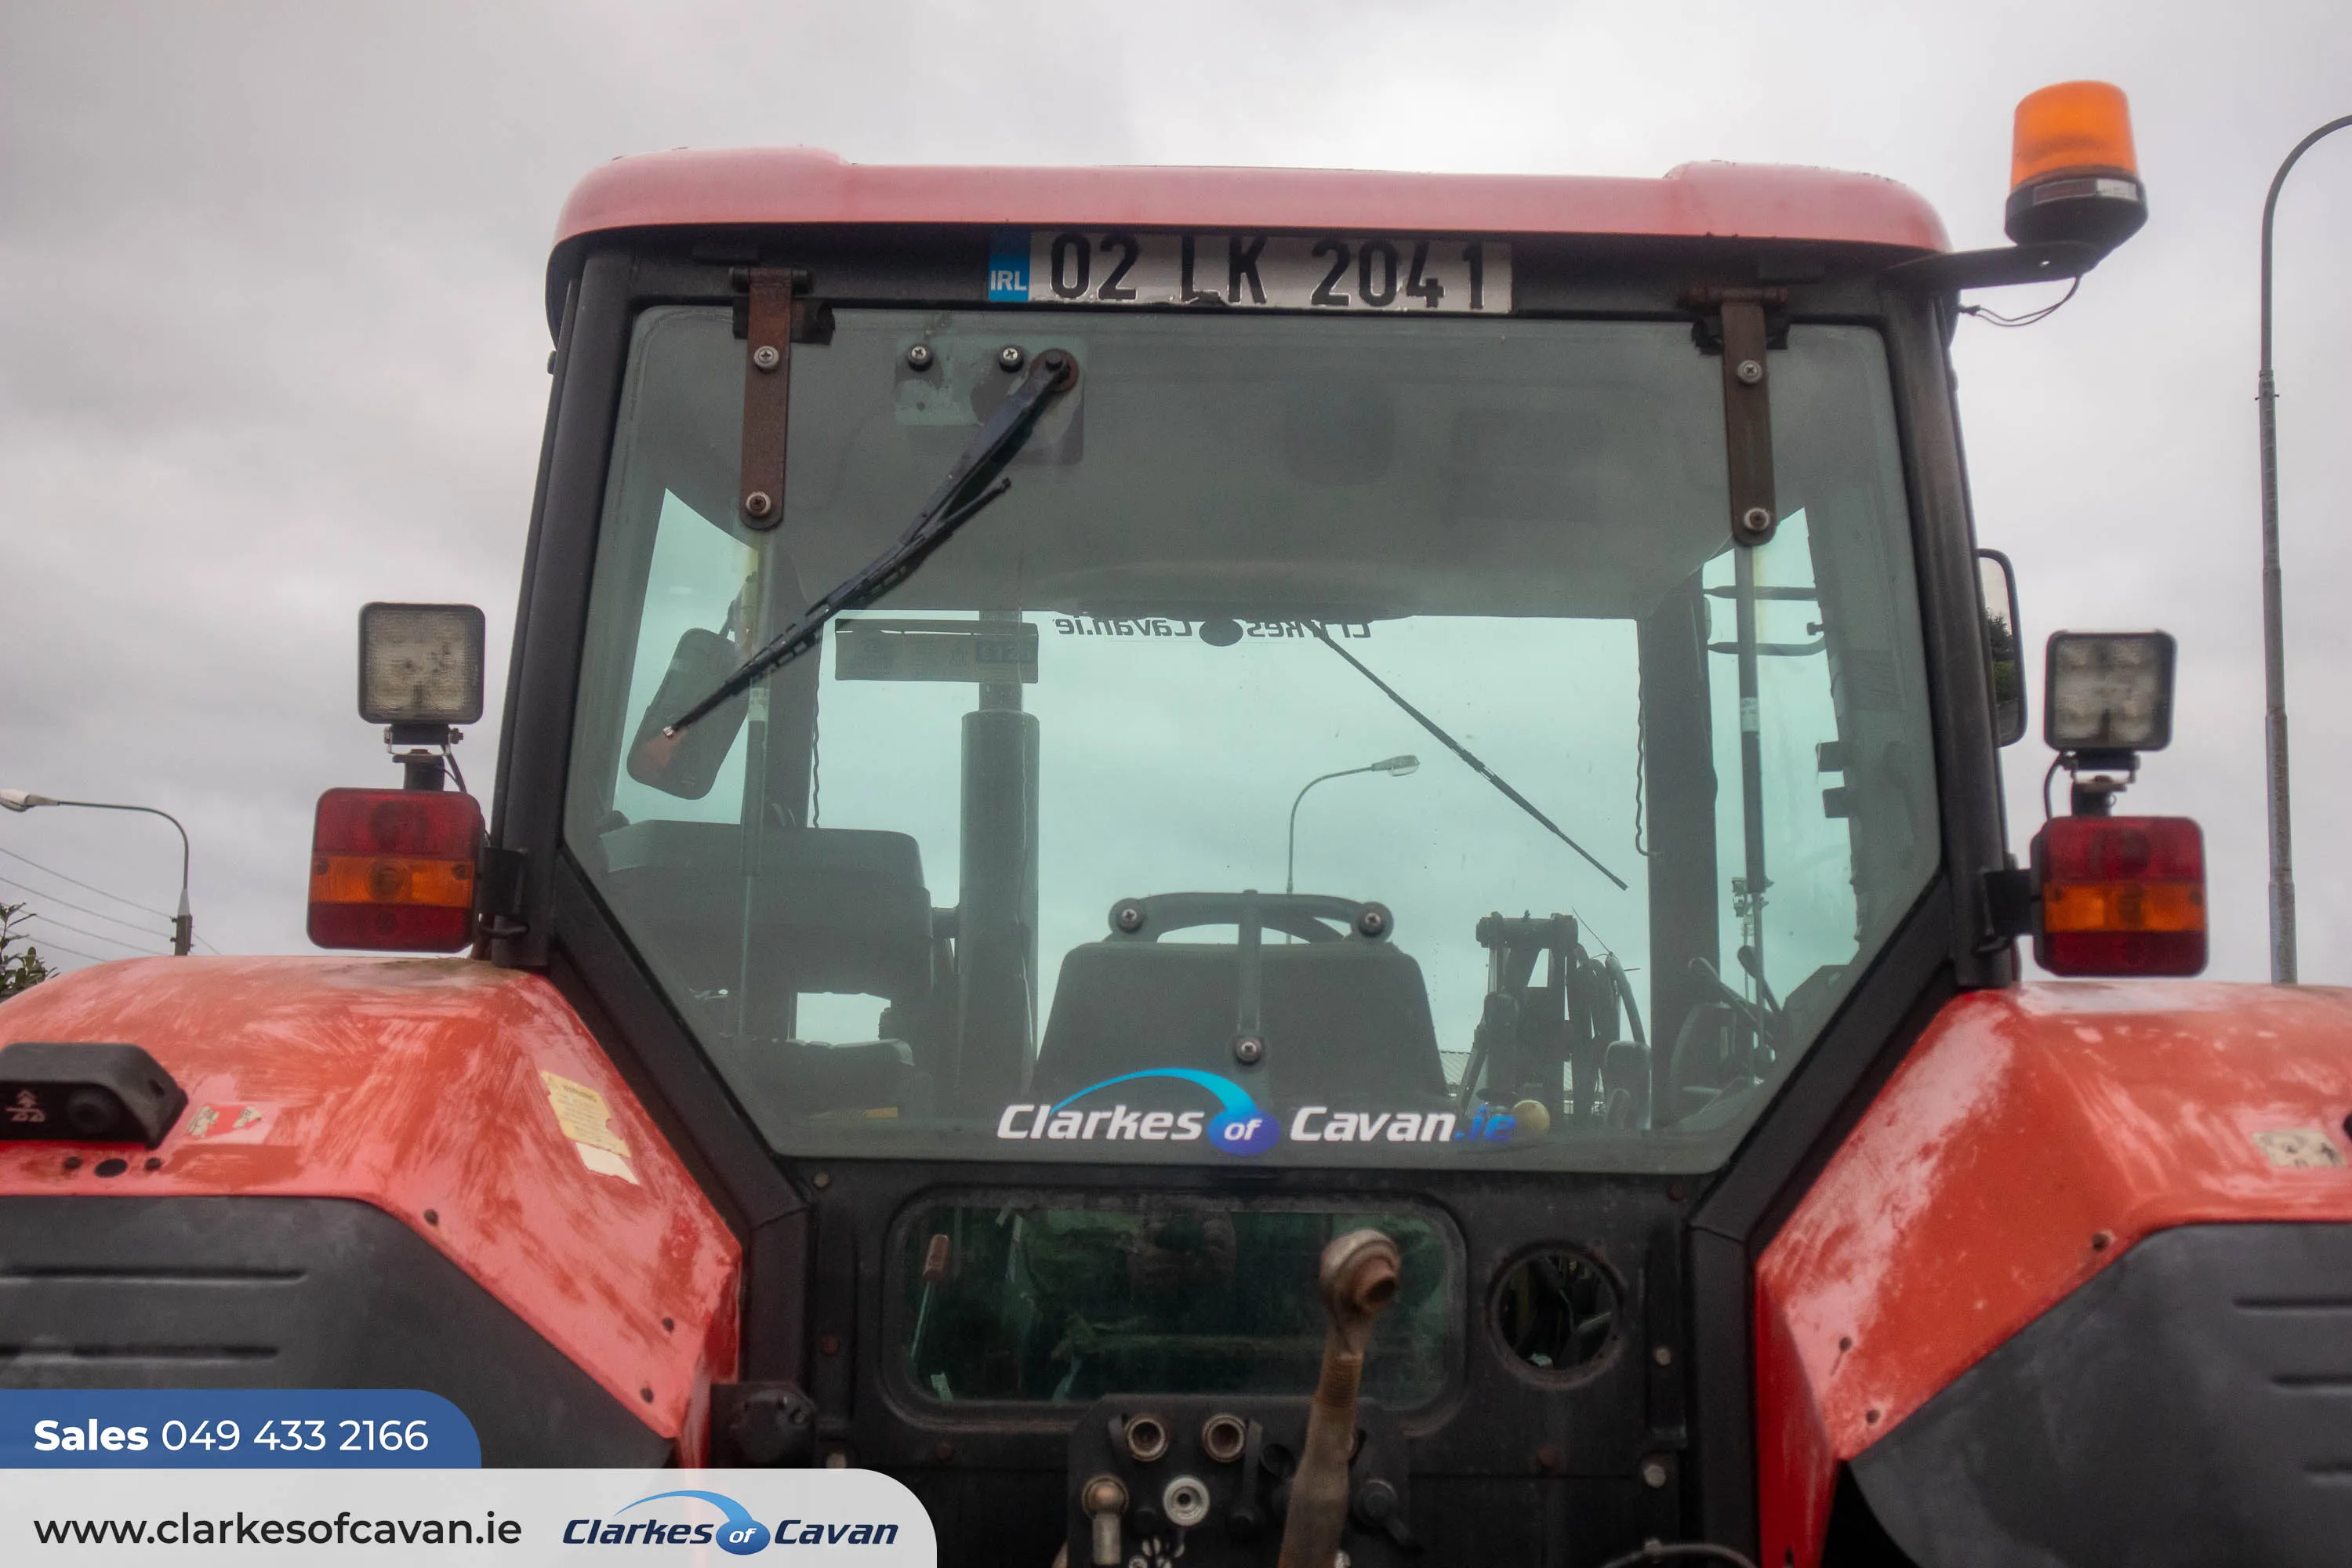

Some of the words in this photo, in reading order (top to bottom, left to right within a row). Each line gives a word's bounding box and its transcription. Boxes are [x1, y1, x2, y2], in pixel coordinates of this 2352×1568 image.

[990, 270, 1027, 291] IRL
[1050, 233, 1138, 300] 02
[1179, 234, 1267, 304] LK
[1310, 238, 1485, 310] 2041
[996, 1104, 1205, 1141] Clarkes
[1224, 1118, 1262, 1142] of
